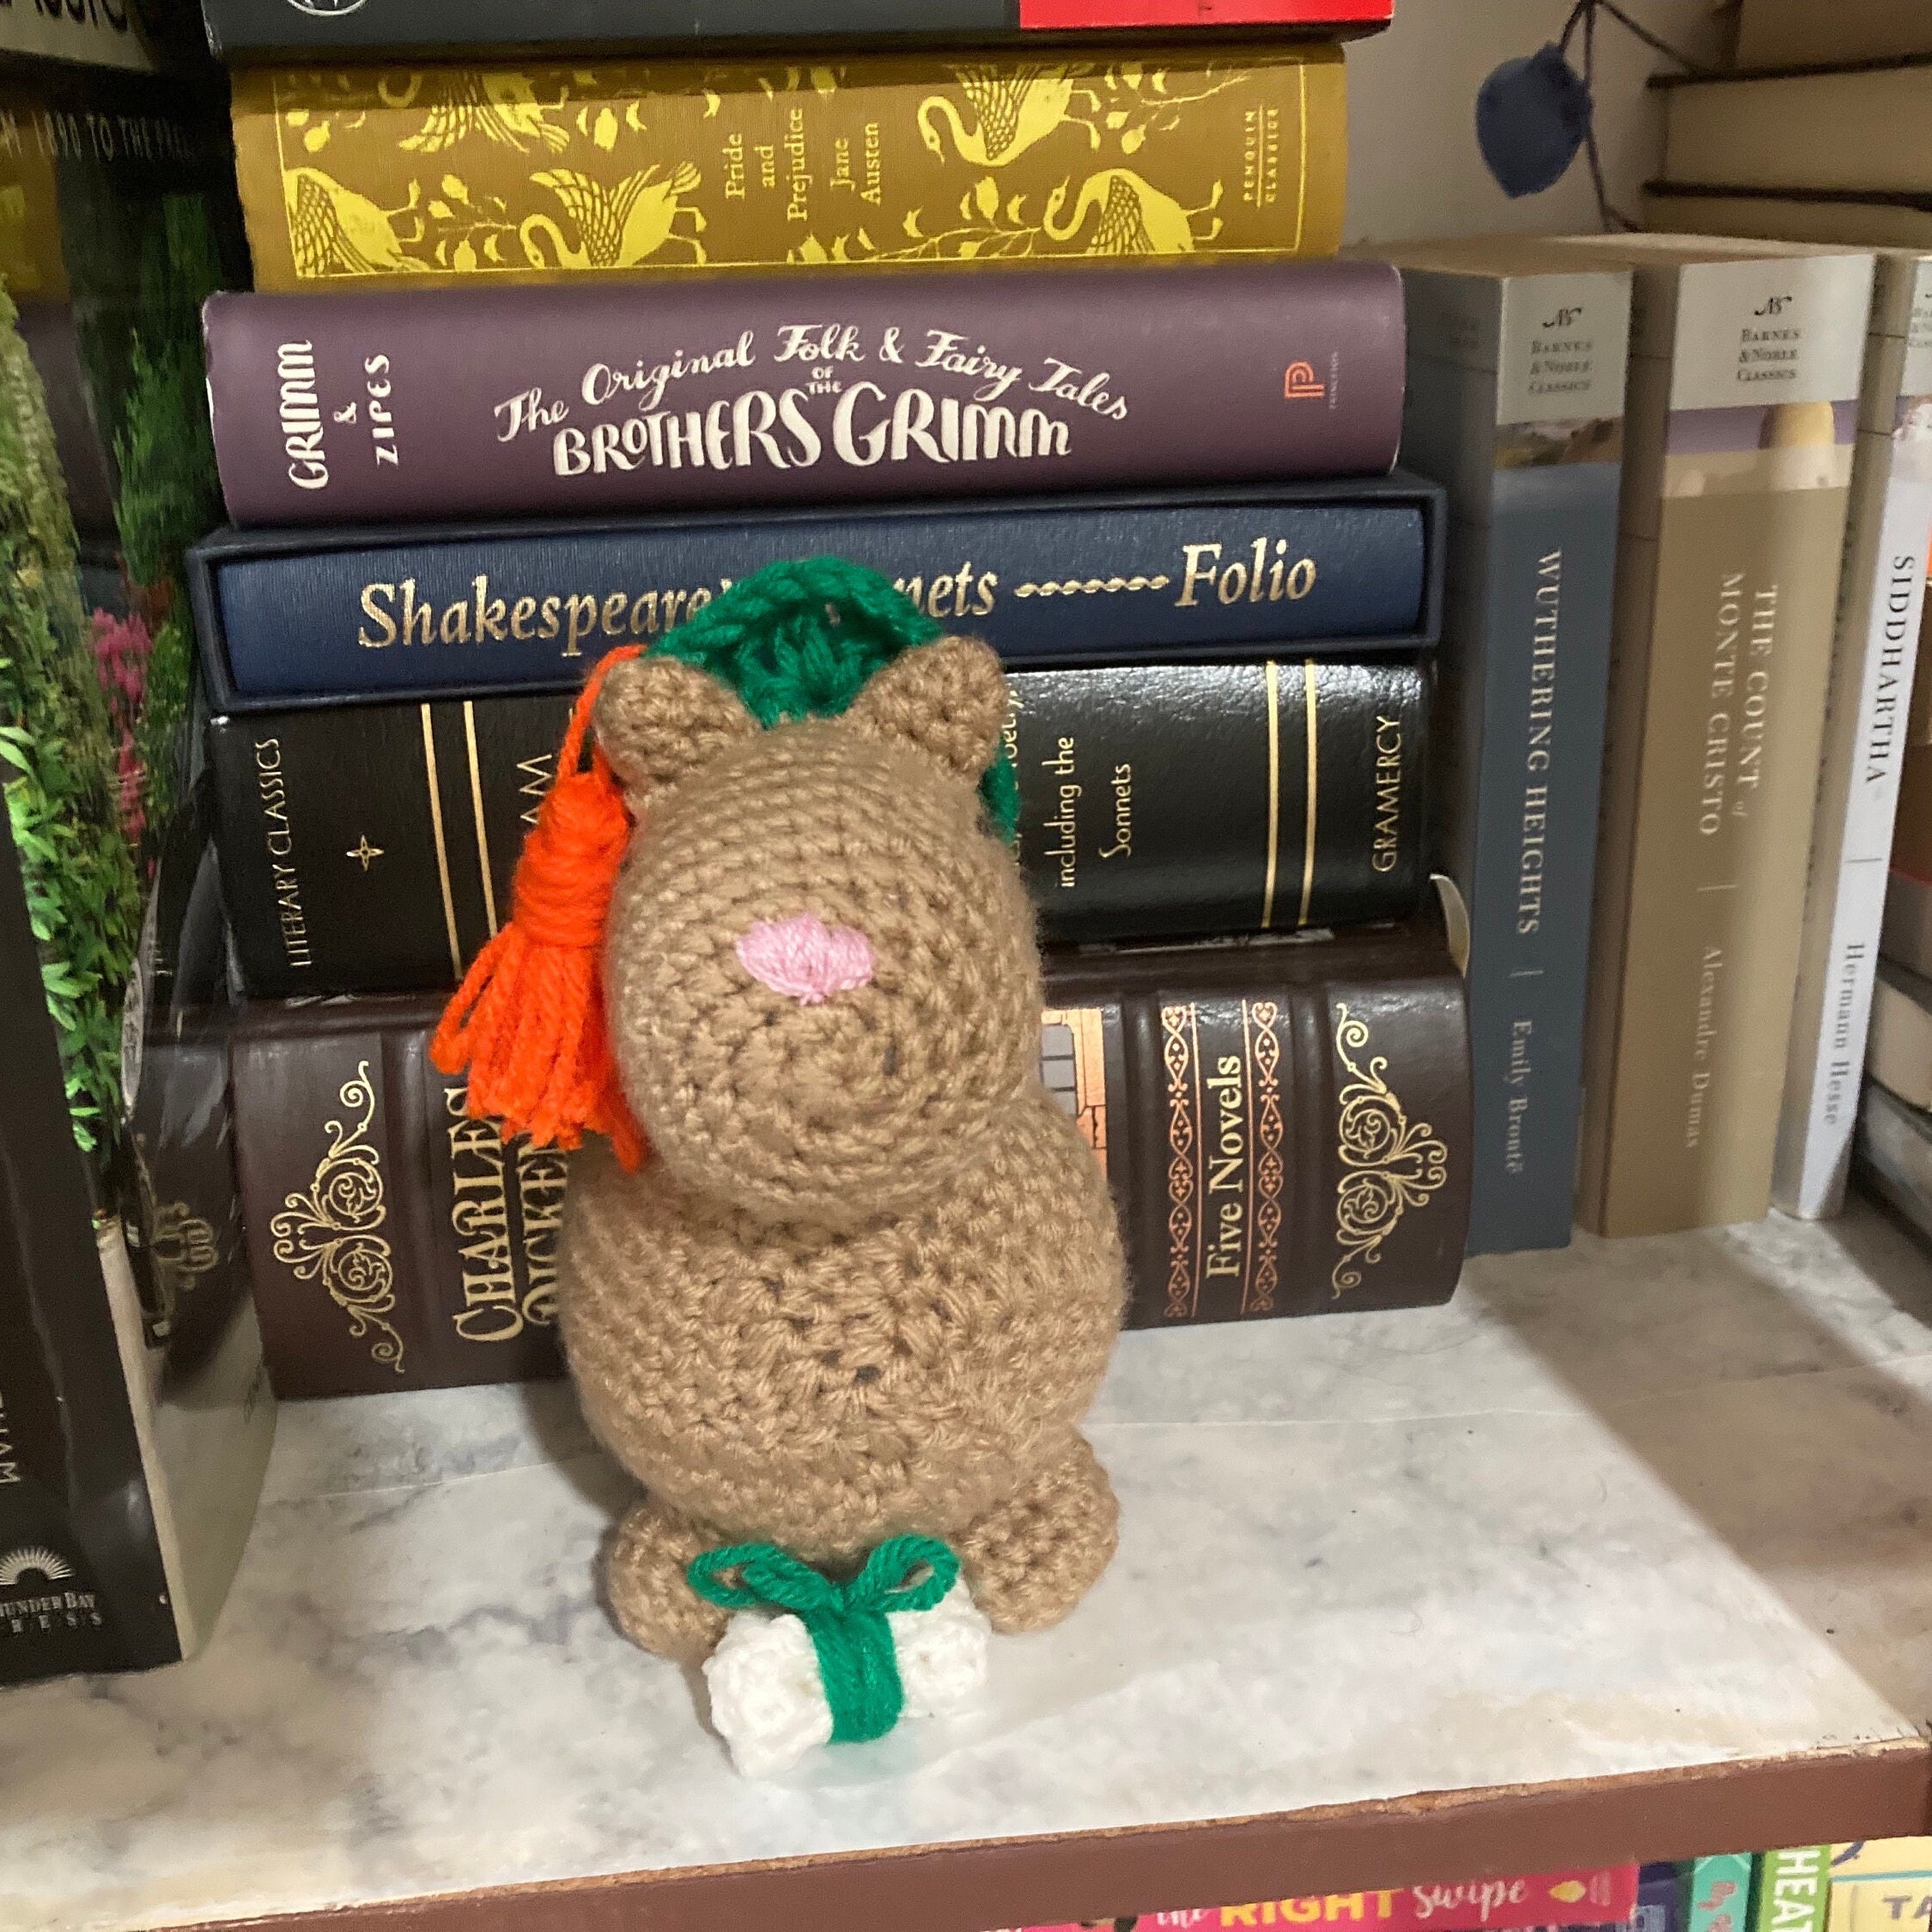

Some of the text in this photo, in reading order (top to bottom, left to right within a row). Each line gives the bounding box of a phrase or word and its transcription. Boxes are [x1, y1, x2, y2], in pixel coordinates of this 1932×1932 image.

[722, 133, 745, 200] Pride
[754, 144, 775, 188] and
[784, 108, 812, 222] Prejudice
[829, 137, 855, 192] Jane
[860, 123, 881, 206] Austen
[277, 339, 329, 489] GRIMM
[334, 402, 356, 424] &
[494, 323, 1127, 442] The Original Folk & Fairy Tales
[553, 380, 1072, 476] BROTHERS GRIMM
[1174, 537, 1317, 608] Folio
[1750, 585, 1778, 657] THE
[1699, 573, 1746, 835] MONTE CRISTO
[1865, 556, 1915, 782] SIDDHARTHA
[1517, 547, 1562, 934] WUTHERING HEIGHTS
[1737, 671, 1769, 789] COUNT
[1041, 736, 1082, 887] including the
[1098, 762, 1132, 858] Sonnets
[1371, 715, 1401, 872] GRAMERCY
[255, 738, 312, 968] LITERARY CLASSICS
[1504, 1020, 1533, 1086] Emily
[1206, 1055, 1243, 1278] Five Novels
